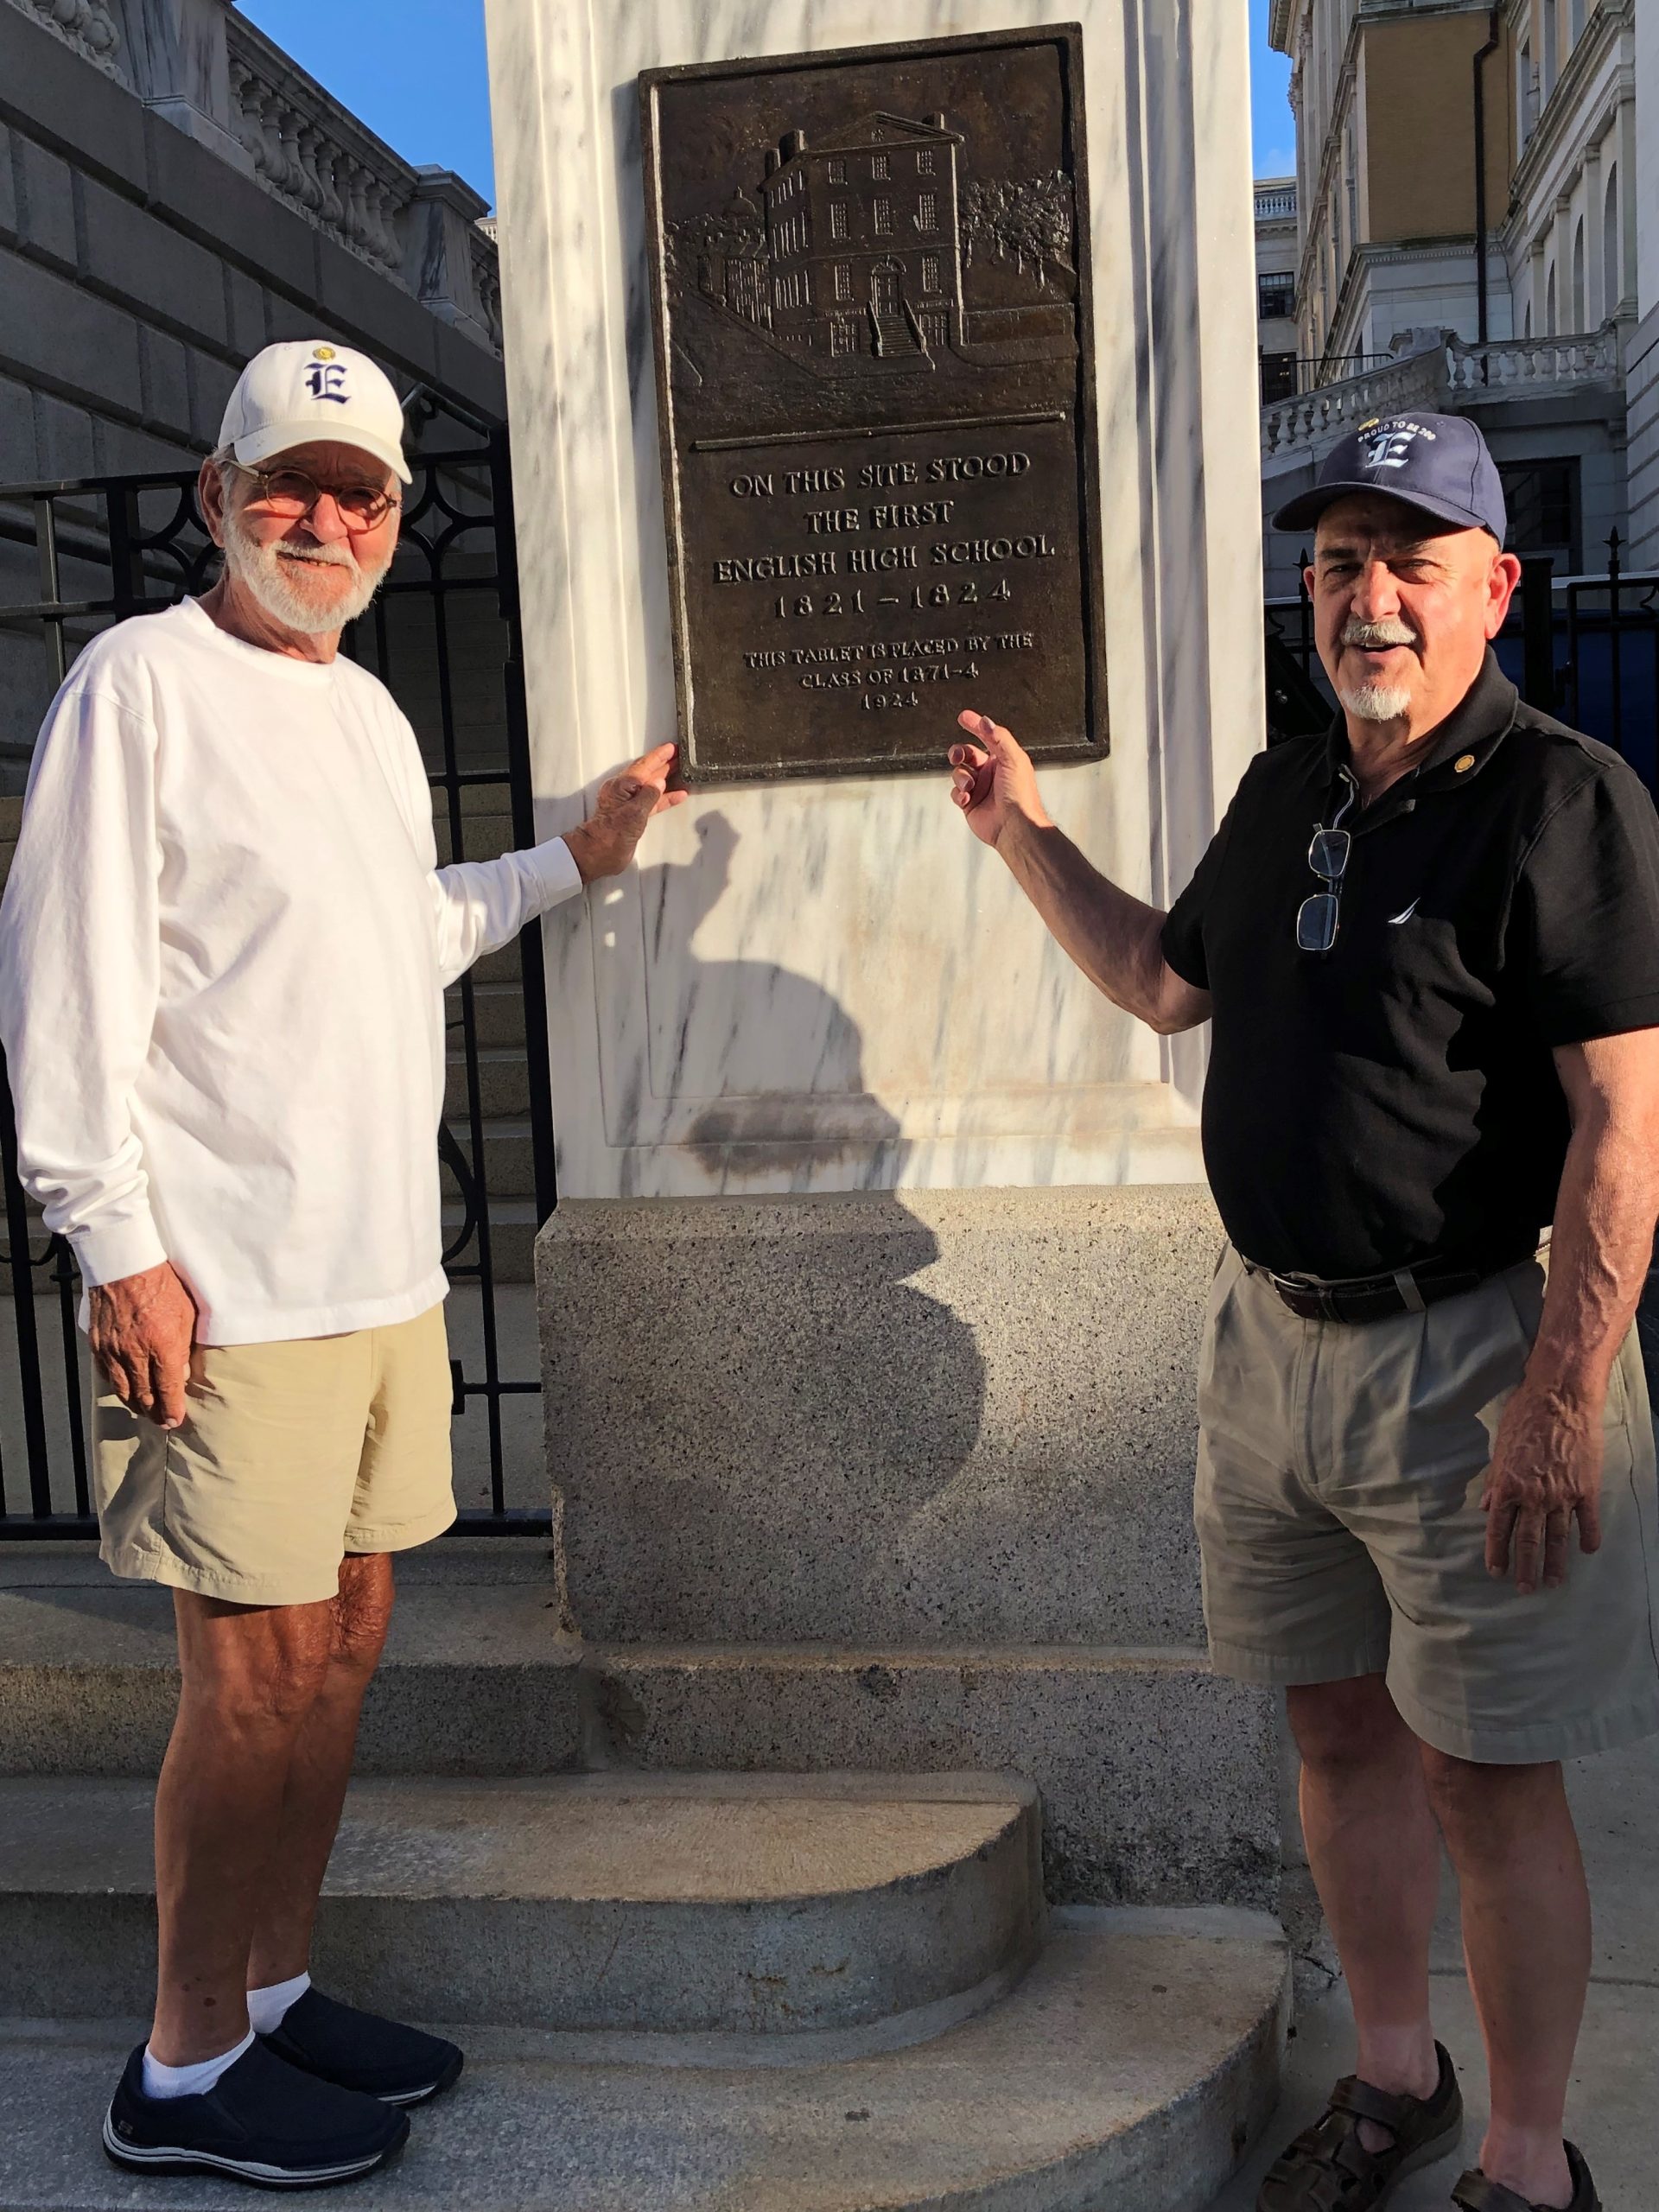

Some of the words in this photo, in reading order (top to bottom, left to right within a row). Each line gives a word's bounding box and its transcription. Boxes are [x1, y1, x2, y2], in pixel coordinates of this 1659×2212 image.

[304, 362, 351, 404] E
[1357, 423, 1389, 442] PROUD
[1392, 420, 1407, 429] TO
[1365, 431, 1417, 468] E
[730, 474, 774, 498] ON
[783, 467, 845, 494] THIS
[858, 461, 918, 489] SITE
[925, 451, 1031, 483] STOOD
[804, 508, 860, 534] THE
[870, 499, 955, 529] FIRST
[714, 551, 836, 583] ENGLISH
[848, 545, 918, 573] HIGH
[930, 534, 1056, 566] SCHOOL
[743, 651, 786, 669] THIS
[790, 645, 864, 664] TABLET
[868, 642, 887, 659] IS
[887, 637, 959, 658] PLACED
[964, 635, 991, 652] BY
[995, 632, 1034, 650] THE
[798, 670, 862, 690] CLASS
[866, 668, 893, 686] OF
[898, 661, 980, 684] 1871-4
[861, 691, 918, 710] 1924
